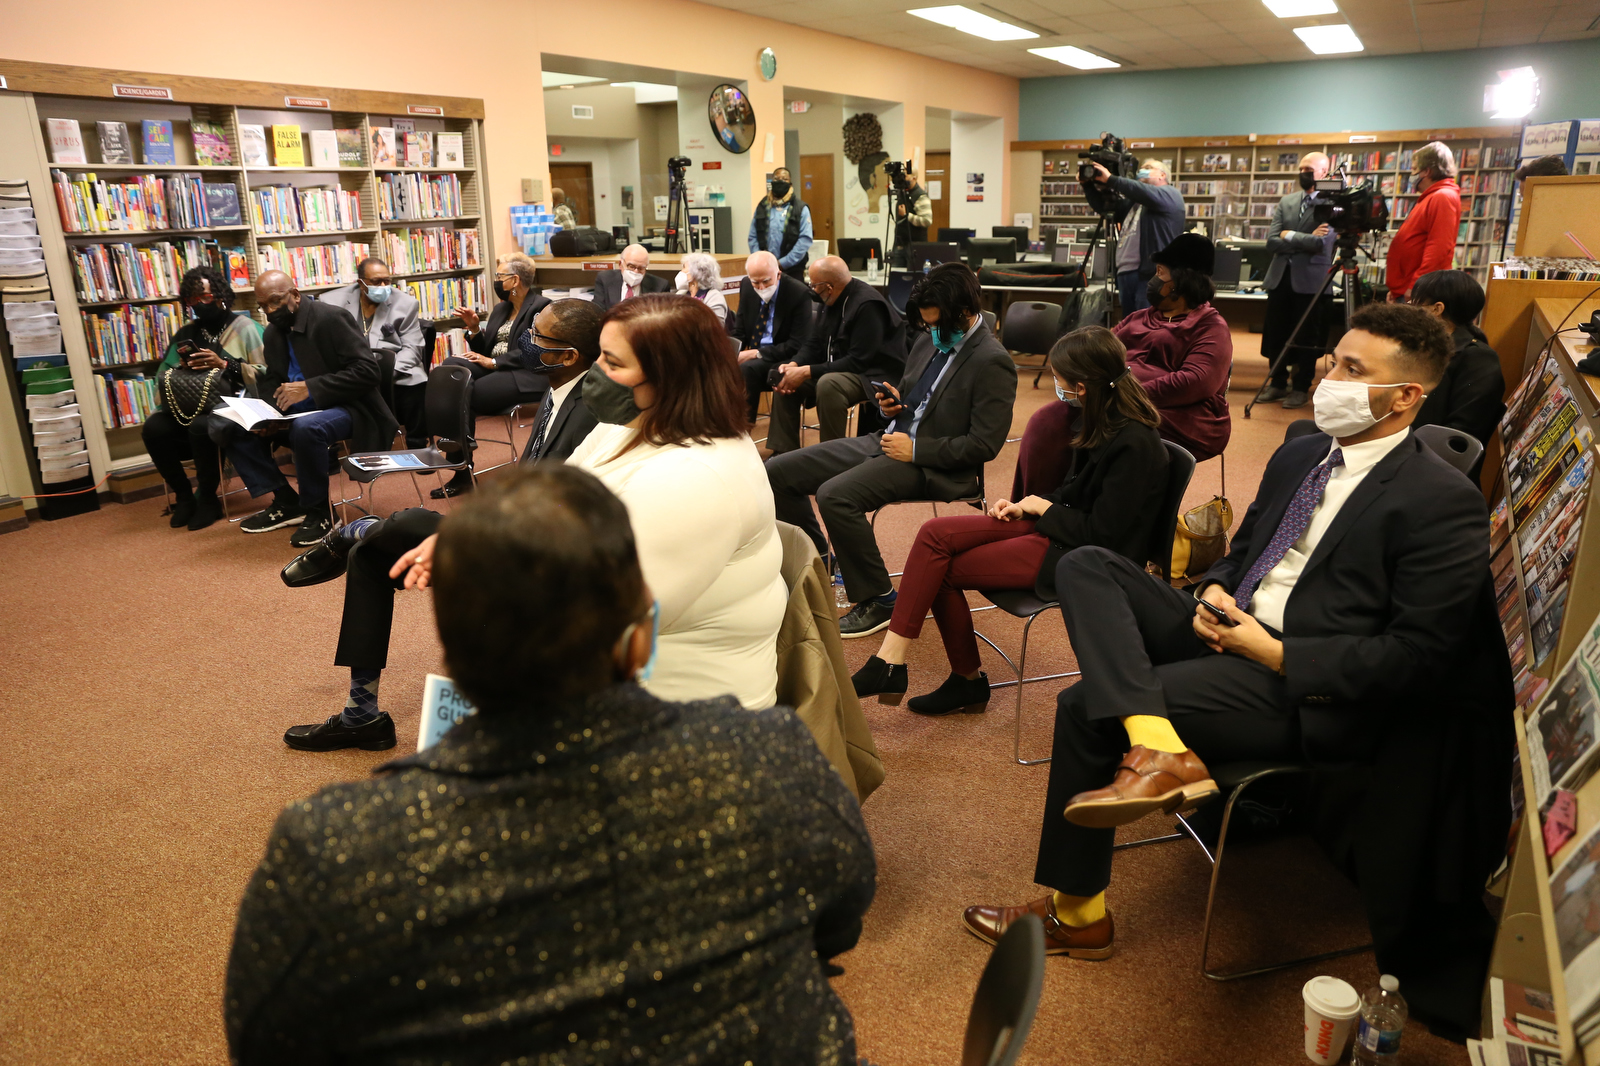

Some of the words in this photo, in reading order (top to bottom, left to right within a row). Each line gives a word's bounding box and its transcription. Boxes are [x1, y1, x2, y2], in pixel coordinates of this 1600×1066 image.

[120, 87, 167, 97] SCIENCE/GARDEN
[148, 133, 170, 143] CARE
[277, 130, 298, 139] FALSE
[54, 136, 80, 147] VIRUS
